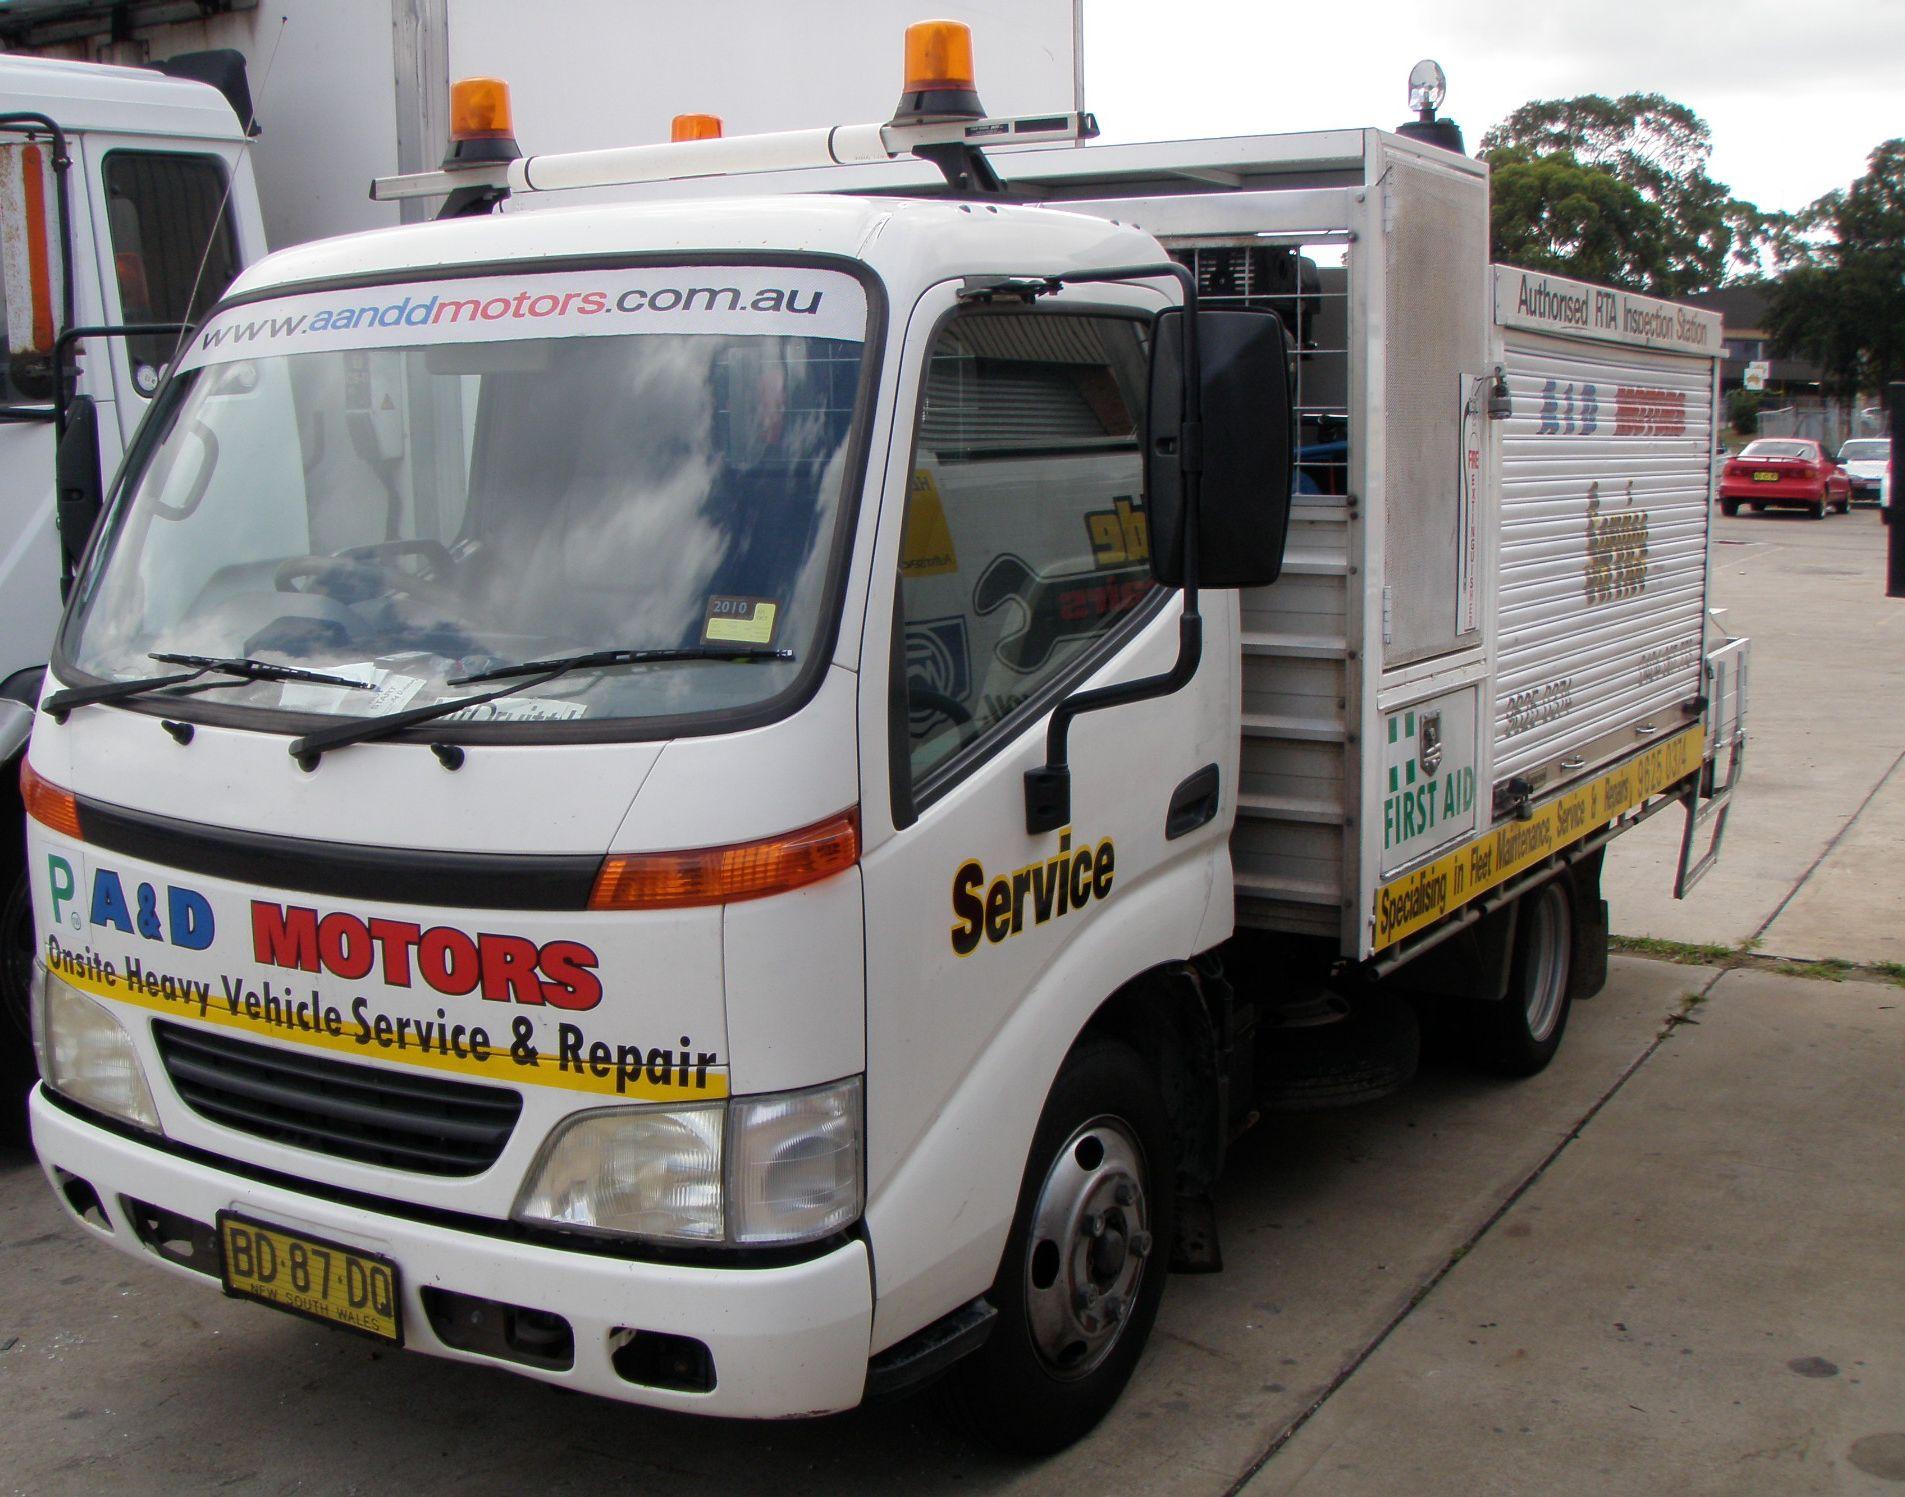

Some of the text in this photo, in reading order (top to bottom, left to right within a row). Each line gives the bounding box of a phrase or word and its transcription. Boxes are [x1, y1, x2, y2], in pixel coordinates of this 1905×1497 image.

[203, 286, 824, 351] www.aanddmotors.com.au
[1518, 274, 1708, 347] Authorised RTA Inspection Station
[712, 600, 748, 615] 2010
[1384, 766, 1475, 850] FIRST AID
[951, 826, 1116, 958] Service
[1380, 866, 1448, 943] Specialising
[1453, 855, 1464, 896] in
[1470, 843, 1492, 887] Fleet
[90, 868, 604, 1012] A&D MOTORS
[48, 934, 718, 1094] Onsite Heavy Vehicle Service & Repair
[251, 1283, 380, 1331] NEW SOUTH WALES
